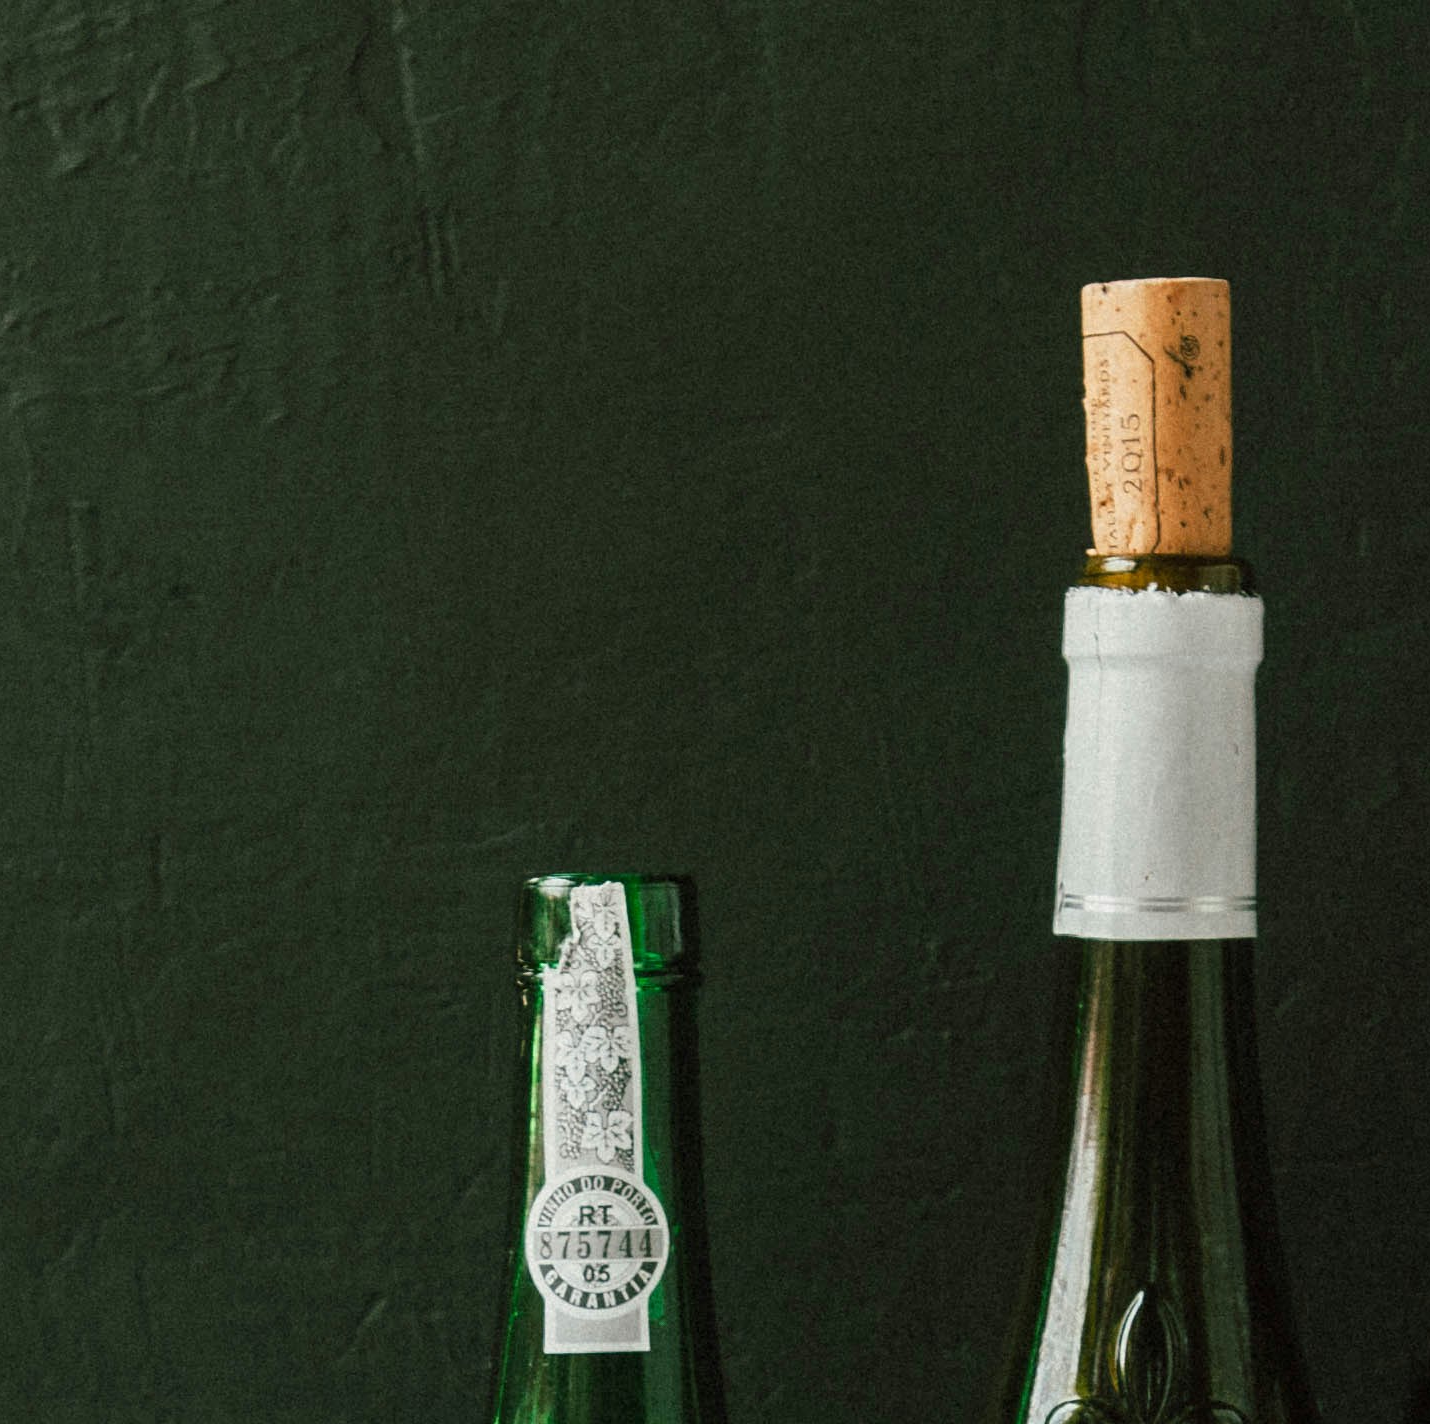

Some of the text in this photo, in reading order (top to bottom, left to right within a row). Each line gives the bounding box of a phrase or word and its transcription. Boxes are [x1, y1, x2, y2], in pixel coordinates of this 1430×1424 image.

[538, 1176, 658, 1227] VINHO DO PORTO
[579, 1205, 612, 1225] RT
[539, 1230, 652, 1260] 875744
[545, 1269, 652, 1308] GARANTIA
[583, 1264, 611, 1283] 05
